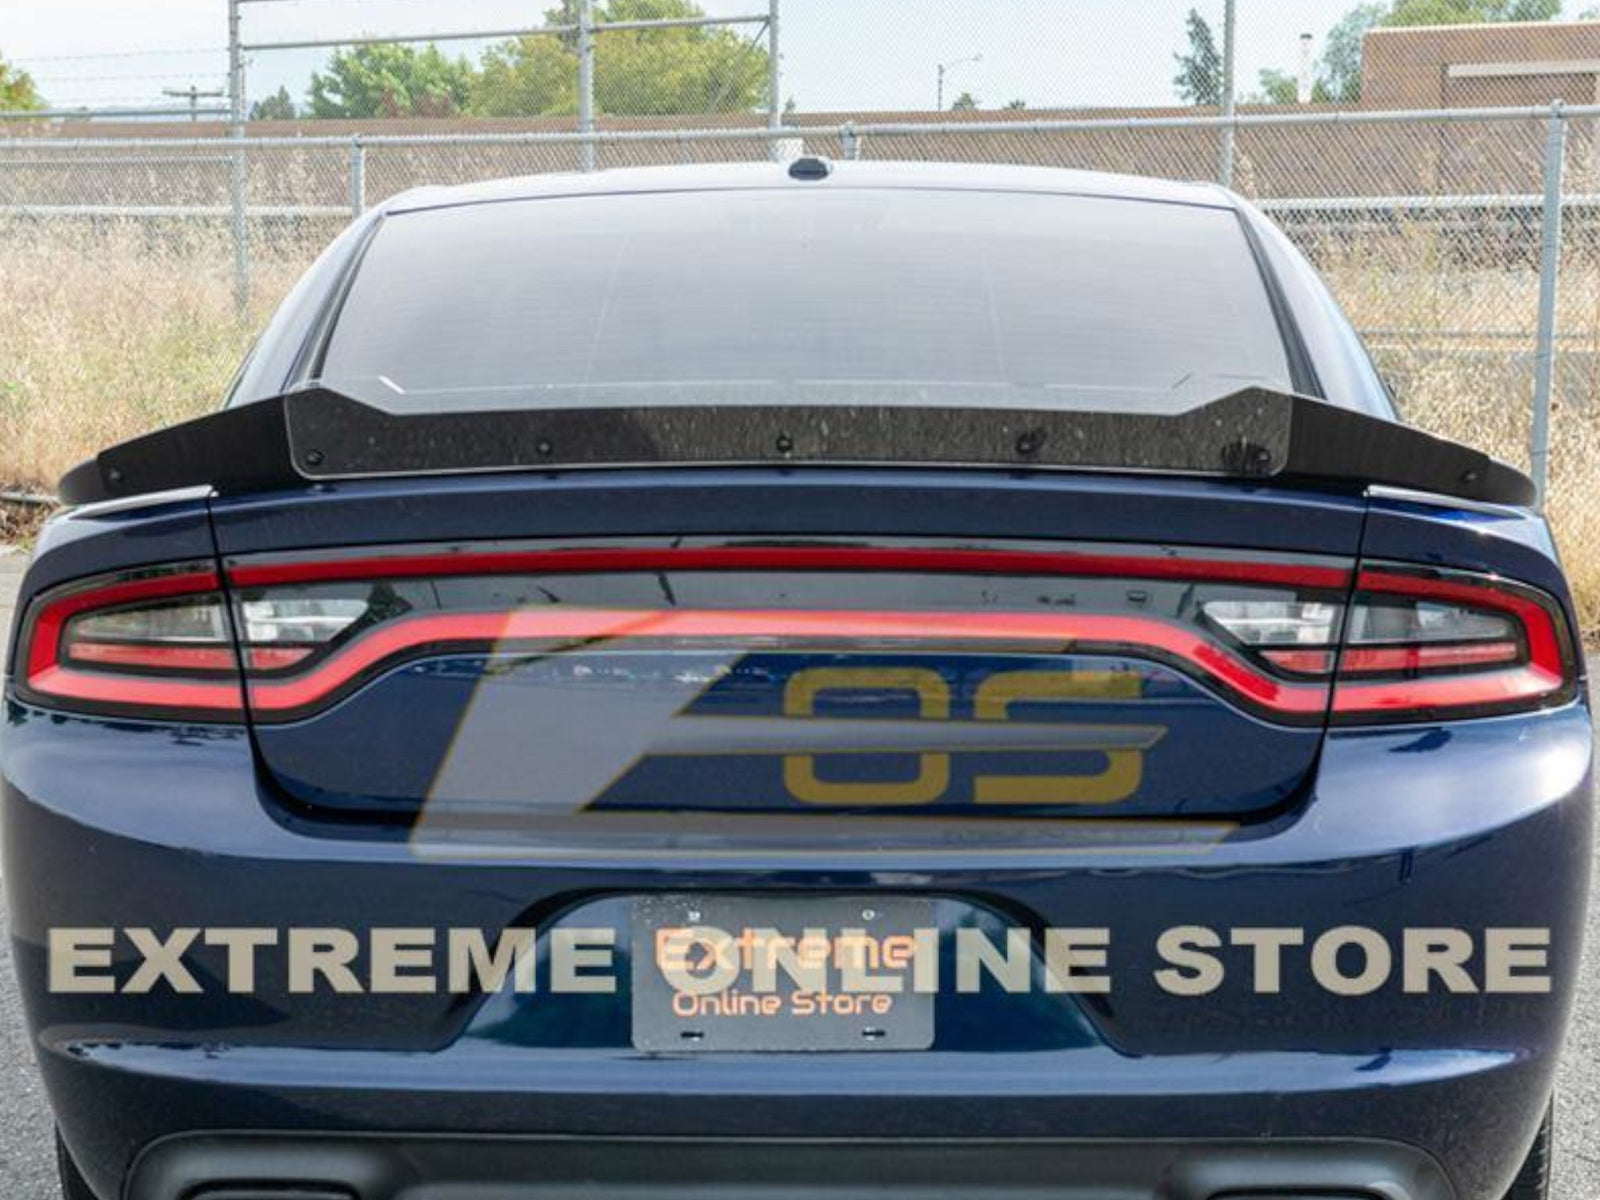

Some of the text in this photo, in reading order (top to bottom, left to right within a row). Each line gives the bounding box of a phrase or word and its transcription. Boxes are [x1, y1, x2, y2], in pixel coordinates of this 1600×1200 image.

[655, 927, 916, 970] Extreme
[672, 988, 893, 1017] Online Store
